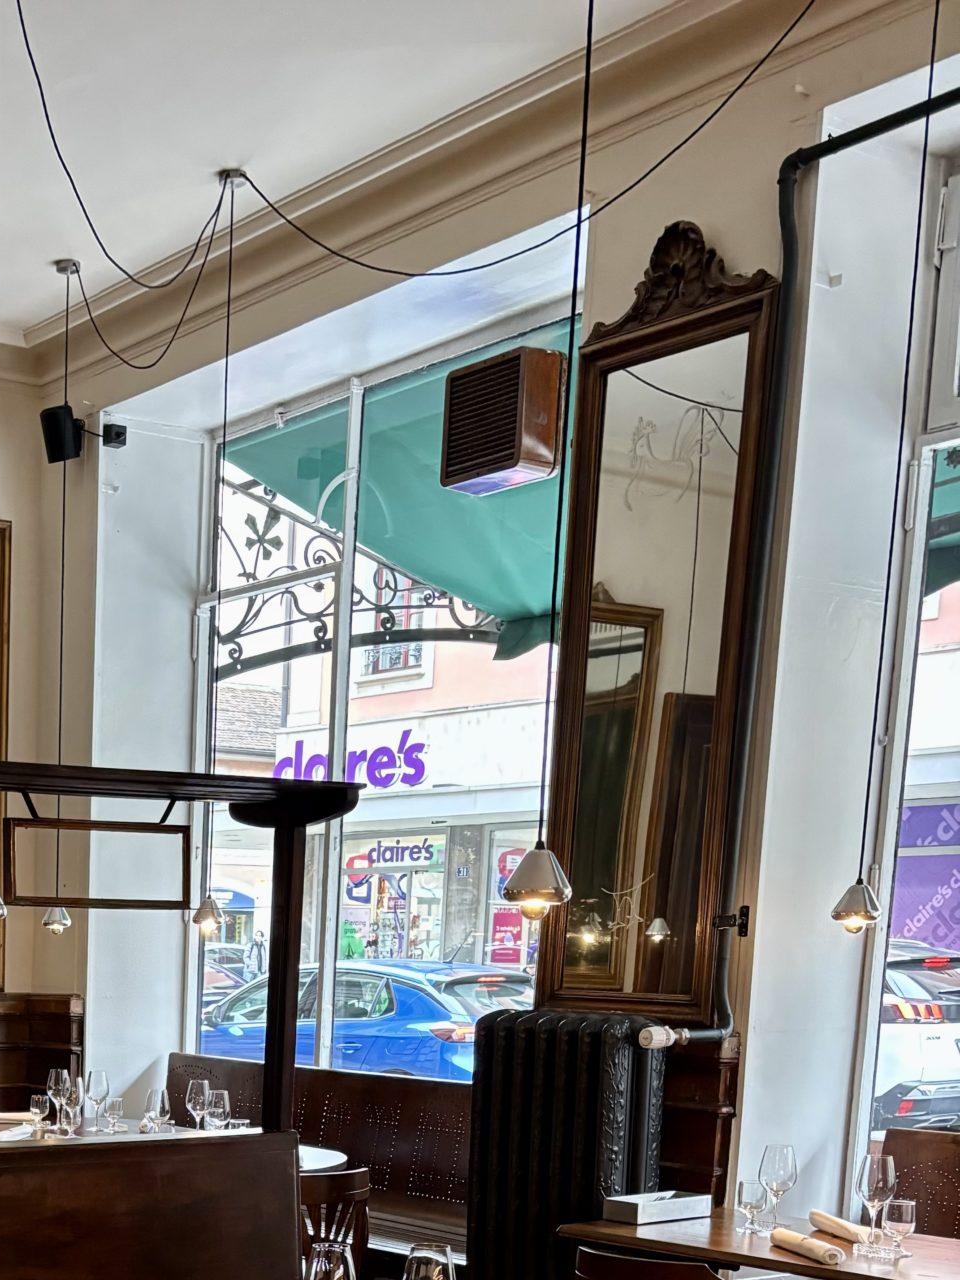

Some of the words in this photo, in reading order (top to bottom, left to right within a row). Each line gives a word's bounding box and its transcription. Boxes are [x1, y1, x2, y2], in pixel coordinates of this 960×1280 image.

[273, 729, 426, 788] clare's
[368, 838, 434, 864] claire's
[903, 884, 953, 938] claire's
